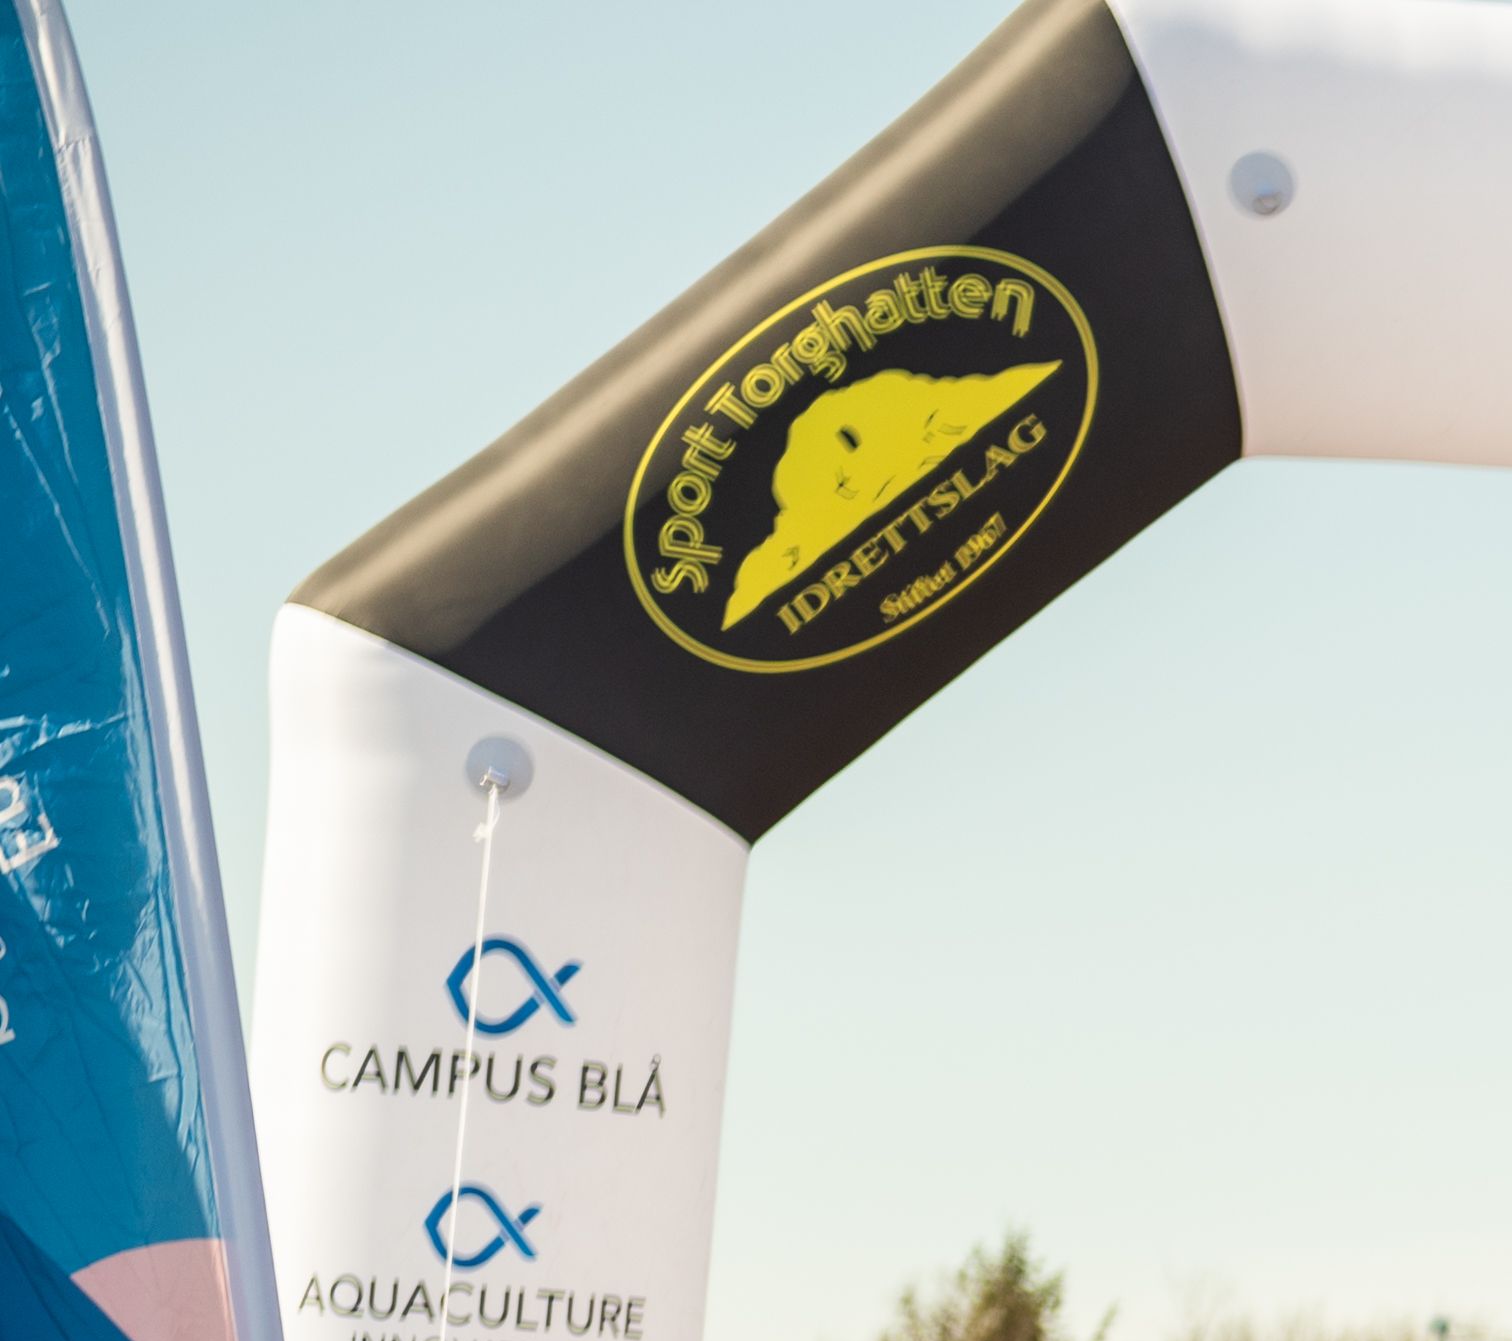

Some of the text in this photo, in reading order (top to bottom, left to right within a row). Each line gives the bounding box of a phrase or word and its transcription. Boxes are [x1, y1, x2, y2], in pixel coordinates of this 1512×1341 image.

[651, 267, 1034, 593] Sport Torghatten
[776, 413, 1048, 635] IDRETTSLAG
[320, 1041, 666, 1117] CAMPUS BLÅ
[299, 1271, 645, 1341] AQUACULTURE
